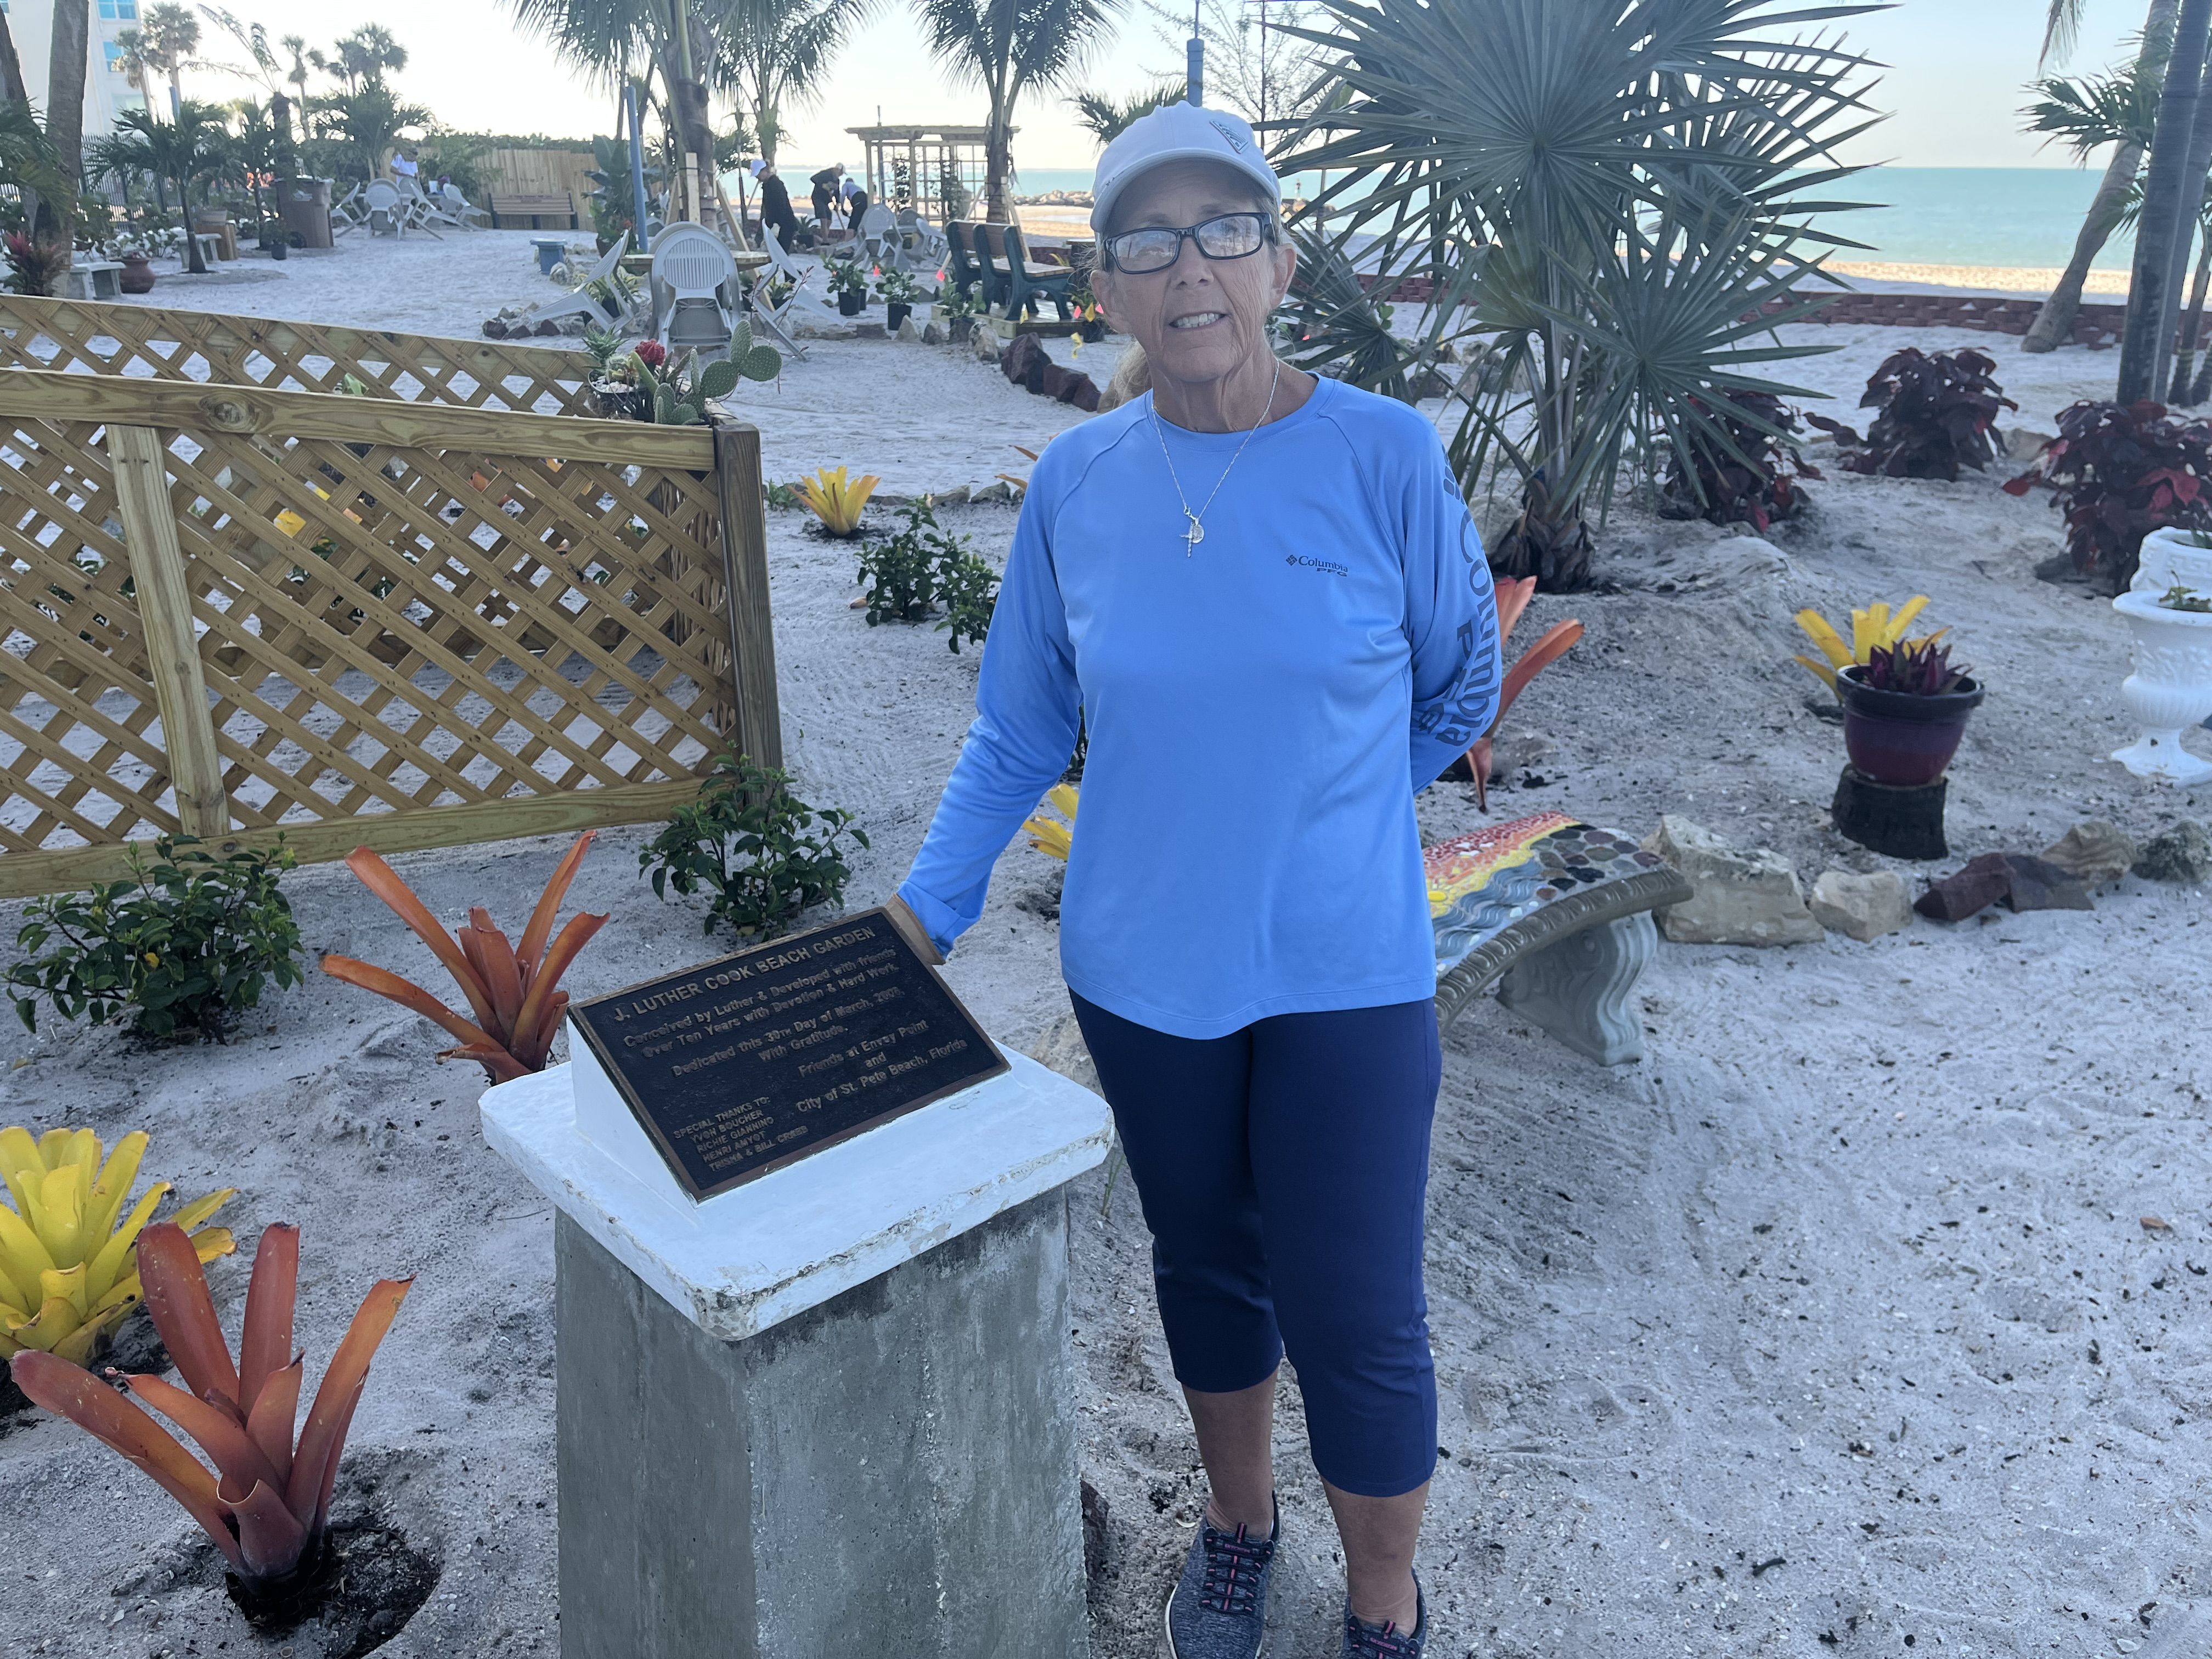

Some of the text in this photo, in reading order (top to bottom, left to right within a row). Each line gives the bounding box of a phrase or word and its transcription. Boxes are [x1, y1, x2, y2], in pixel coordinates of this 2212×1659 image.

[1298, 555, 1348, 572] Columbia
[1317, 567, 1347, 577] PFG
[1435, 508, 1500, 747] Columbia
[614, 926, 876, 1022] J. LUTHER COOK BEACH GARDEN
[623, 949, 897, 1047] Conceived by Luther & Developed with friends
[642, 963, 900, 1058] Over Ten Years with Devotion & Hard Work.
[671, 1046, 736, 1077] Dedicated
[737, 1038, 763, 1052] this
[793, 1018, 817, 1032] Day
[820, 1010, 833, 1023] of
[834, 998, 874, 1018] March,
[758, 1025, 848, 1062] With Gratitude.
[798, 1053, 844, 1077] Friends
[846, 1045, 860, 1058] at
[898, 1019, 929, 1037] Point
[797, 1038, 968, 1112] City of St. Pete Beach, Florida
[864, 1052, 887, 1068] and
[673, 1097, 771, 1139] SPECIAL THANKS TO:
[691, 1109, 764, 1143] YVON BOUCHER
[697, 1116, 774, 1153] RICHIE GIANNINO
[702, 1131, 766, 1163] HENRI AMYOT
[746, 1149, 754, 1157] &
[754, 1139, 777, 1151] BILL
